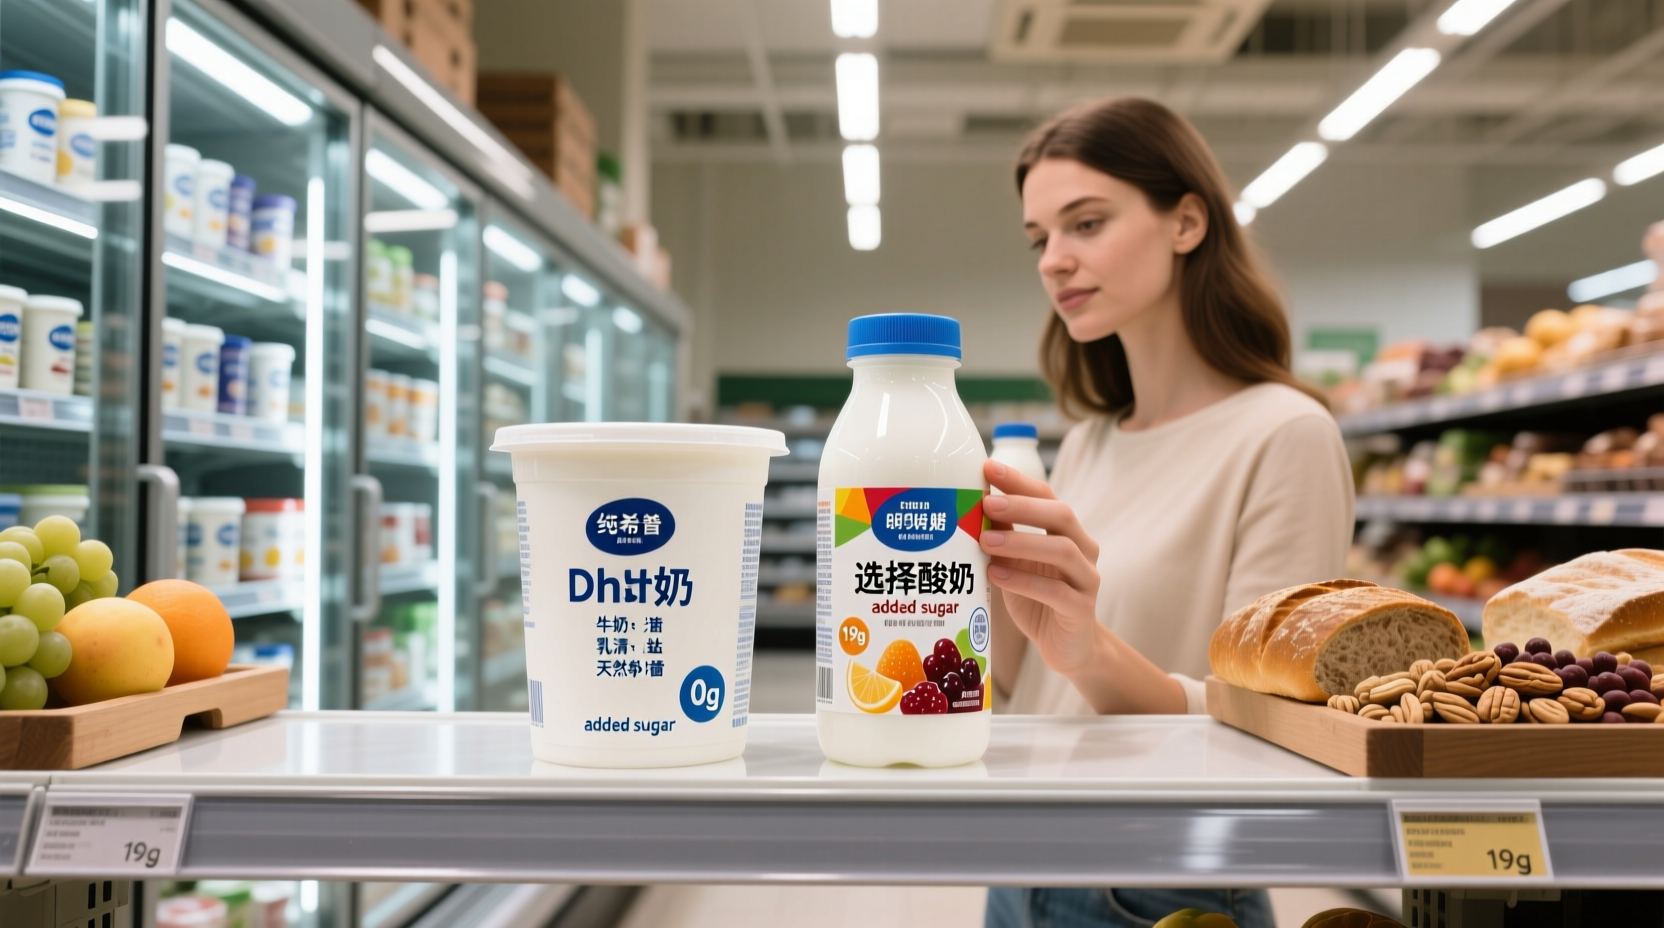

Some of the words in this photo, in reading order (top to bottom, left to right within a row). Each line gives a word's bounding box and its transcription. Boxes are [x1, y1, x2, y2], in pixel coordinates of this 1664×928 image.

[854, 560, 975, 595] 选择酸奶
[872, 599, 917, 614] added
[921, 601, 960, 617] sugar
[842, 626, 866, 646] 19g
[690, 678, 720, 711] 0g
[584, 716, 630, 732] added
[633, 719, 676, 736] sugar
[124, 841, 161, 868] 19g
[1486, 848, 1532, 875] 19g
